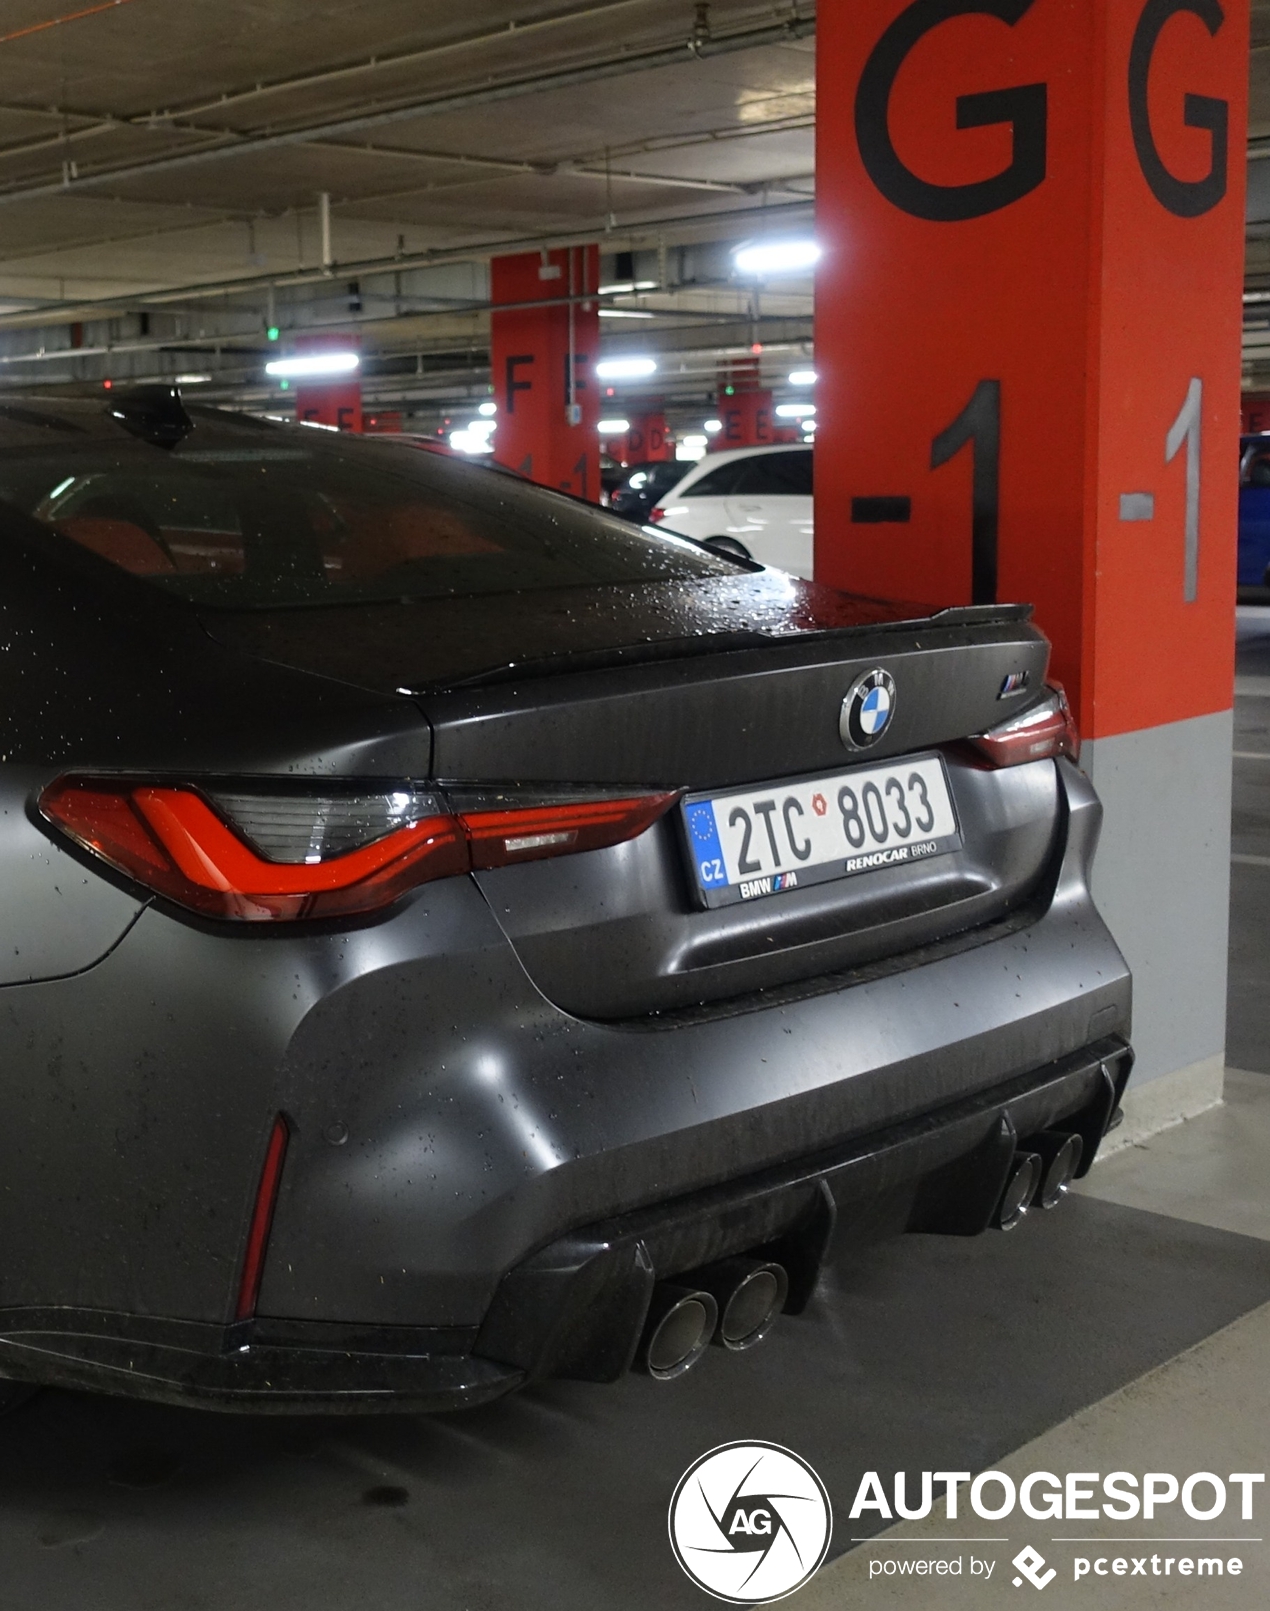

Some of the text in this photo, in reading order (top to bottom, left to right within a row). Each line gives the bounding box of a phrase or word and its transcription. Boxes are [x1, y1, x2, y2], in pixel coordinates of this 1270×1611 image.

[854, 0, 1047, 221] G
[1129, 0, 1228, 218] G
[506, 355, 534, 413] F
[725, 410, 741, 439] E
[851, 379, 1000, 604] -1
[1119, 376, 1202, 603] -1
[729, 772, 934, 875] 2TC 8033
[846, 841, 937, 872] RENOCAR BRNO
[701, 859, 724, 882] CZ
[740, 877, 771, 899] BMW
